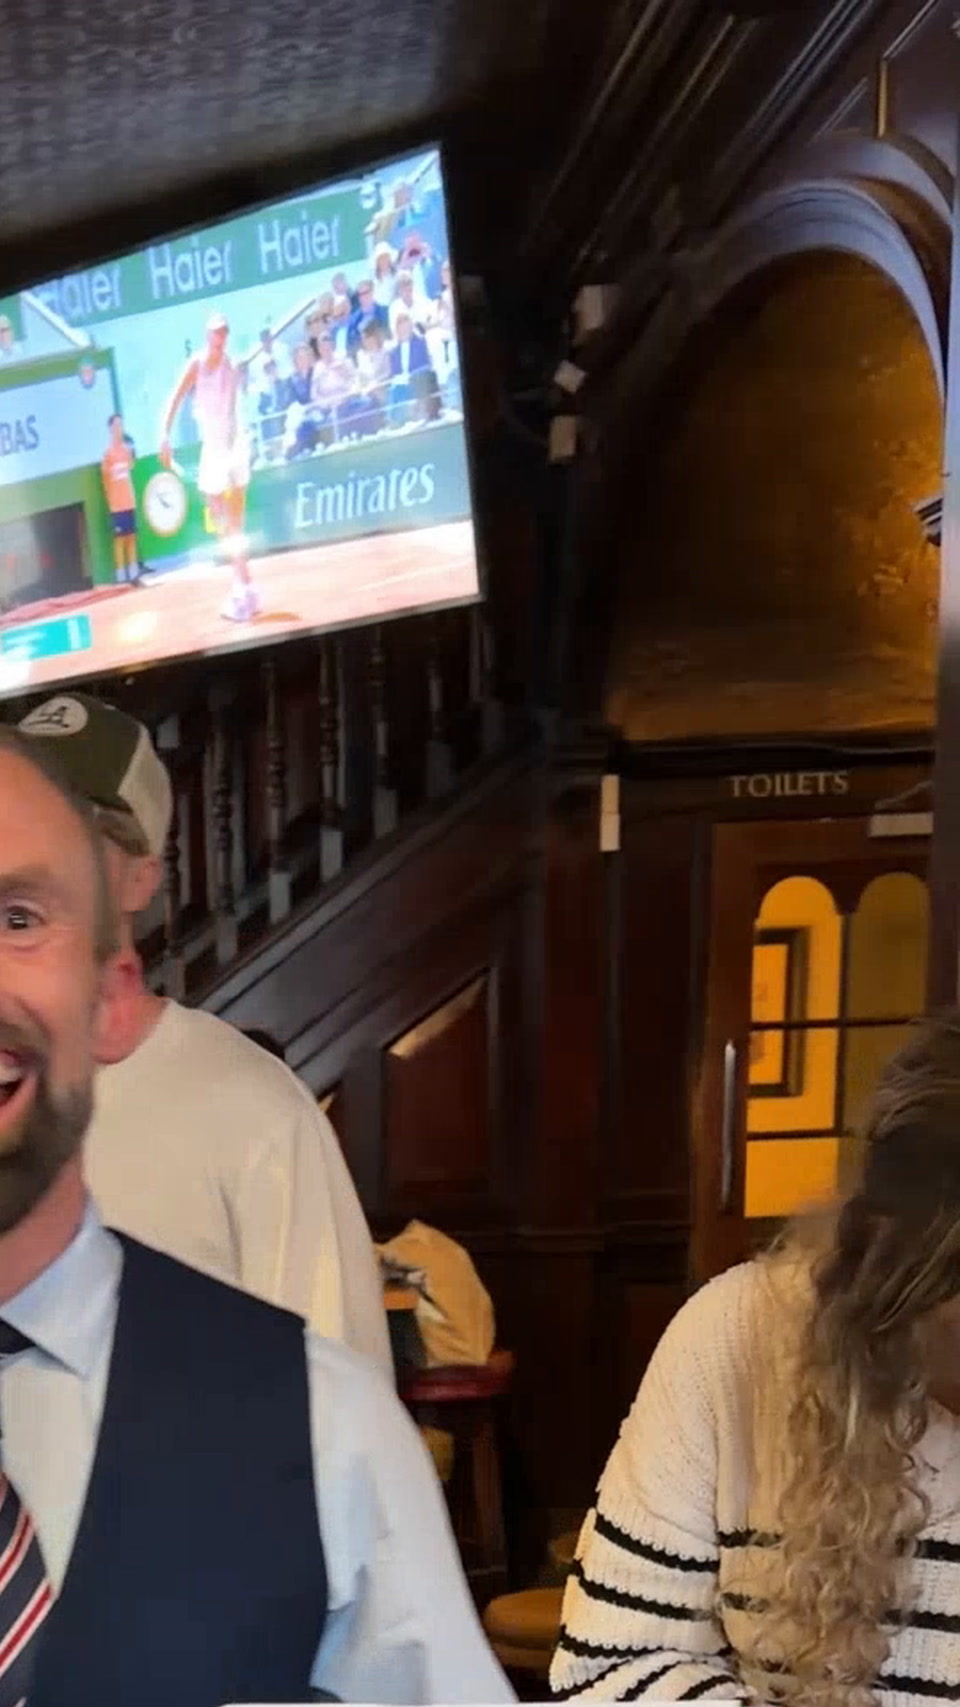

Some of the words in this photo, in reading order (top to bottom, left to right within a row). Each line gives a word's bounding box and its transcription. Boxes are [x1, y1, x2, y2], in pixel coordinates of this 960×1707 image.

[149, 237, 234, 299] Haier
[258, 211, 340, 272] Haier
[294, 462, 436, 529] Emirates
[729, 770, 849, 798] TOILETS
